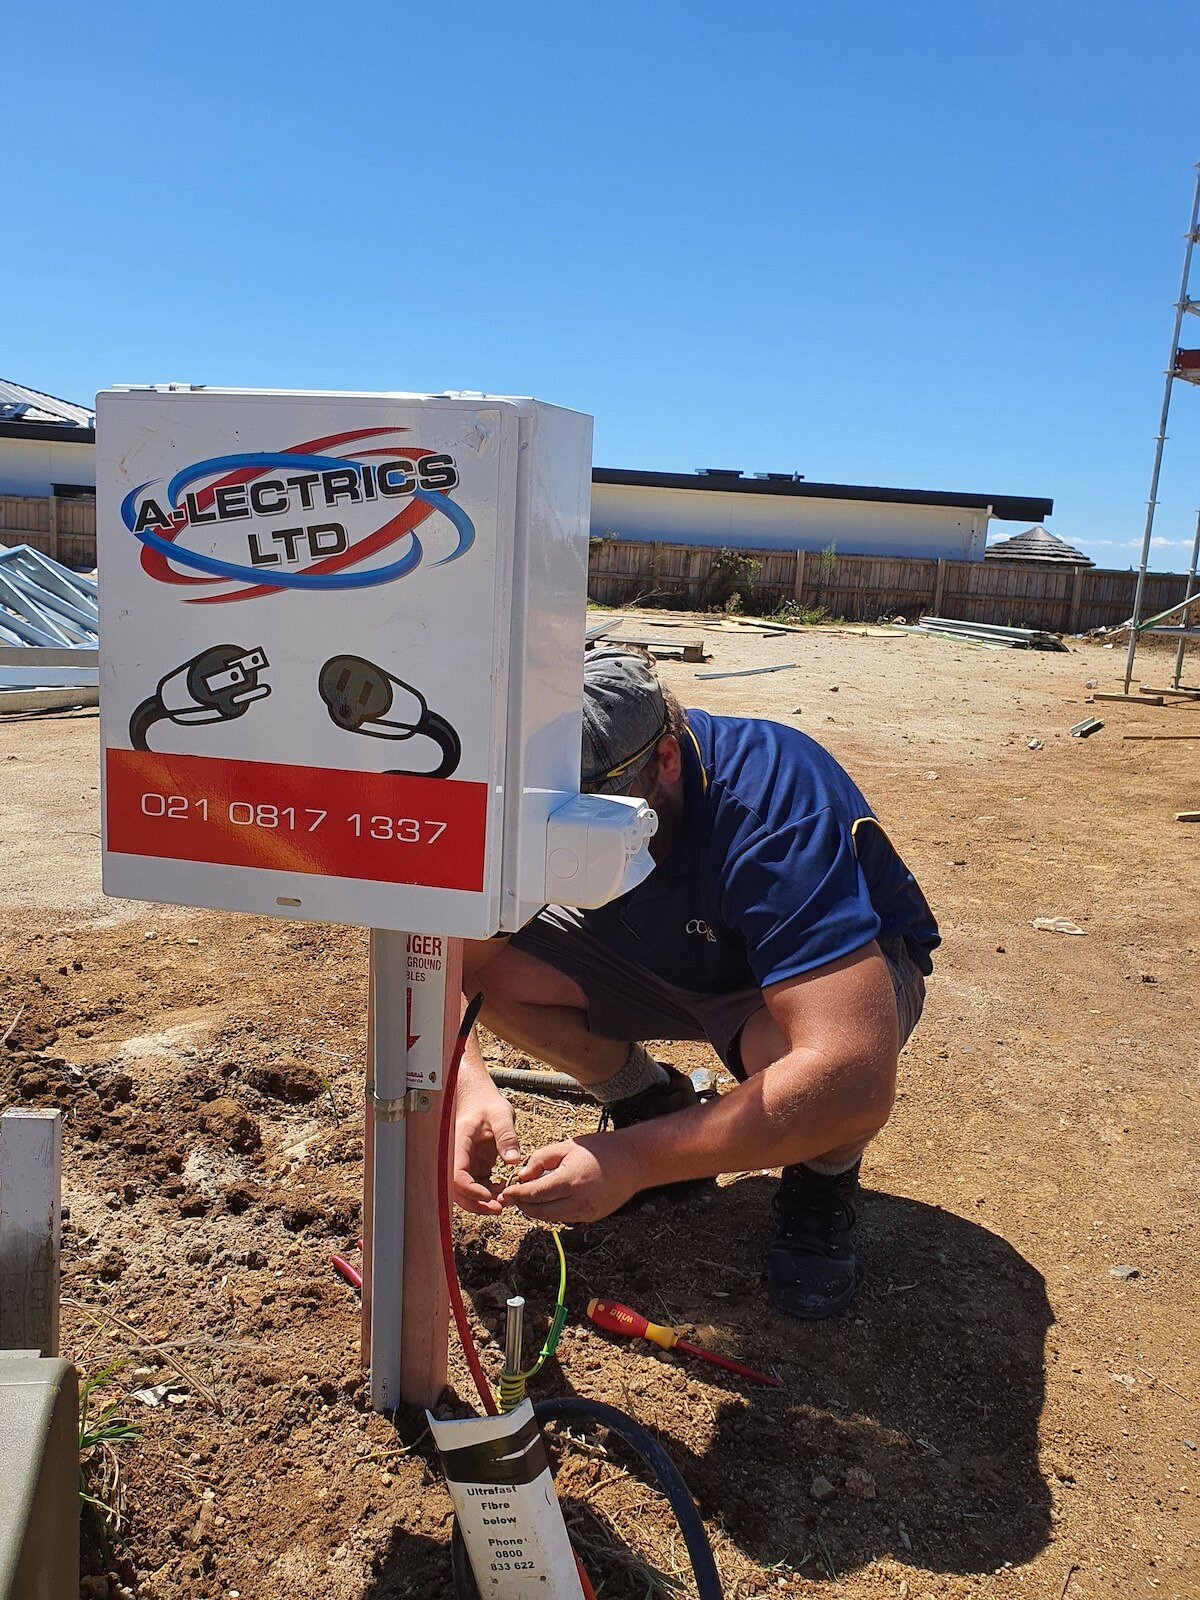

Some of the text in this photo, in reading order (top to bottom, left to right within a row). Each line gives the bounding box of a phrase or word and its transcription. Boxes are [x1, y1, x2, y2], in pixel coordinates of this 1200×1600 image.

[134, 453, 459, 533] A-LECTRICS
[247, 521, 351, 567] LTD
[141, 793, 449, 845] 021 0817 1337
[467, 1485, 517, 1496] Ultrafast
[481, 1502, 510, 1510] Fibre
[483, 1516, 516, 1524] below
[495, 1550, 523, 1558] 0800
[491, 1561, 535, 1571] 833 622
